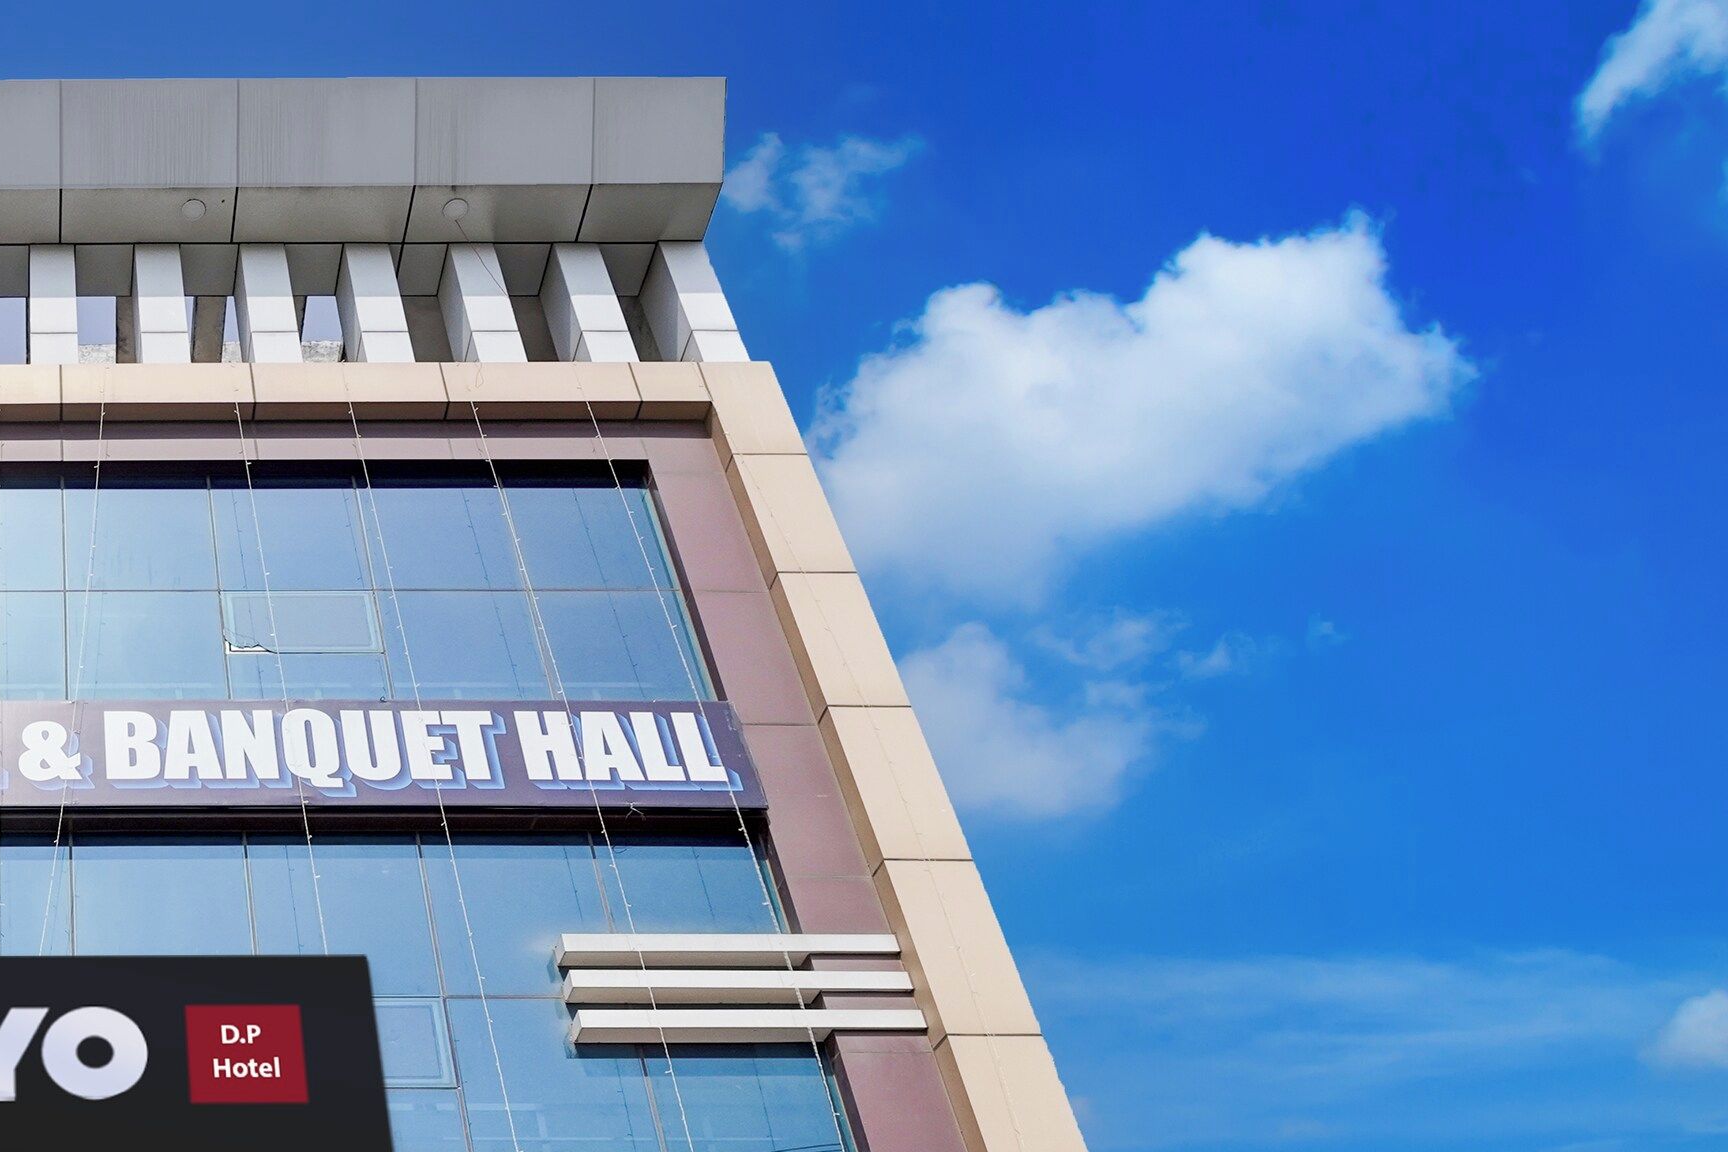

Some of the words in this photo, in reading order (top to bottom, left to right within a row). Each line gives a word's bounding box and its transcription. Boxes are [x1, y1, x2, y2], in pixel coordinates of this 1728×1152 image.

[18, 720, 83, 783] &
[103, 708, 495, 788] BANQUET
[514, 710, 733, 783] HALL
[219, 1024, 262, 1046] D.P
[212, 1057, 282, 1079] Hotel
